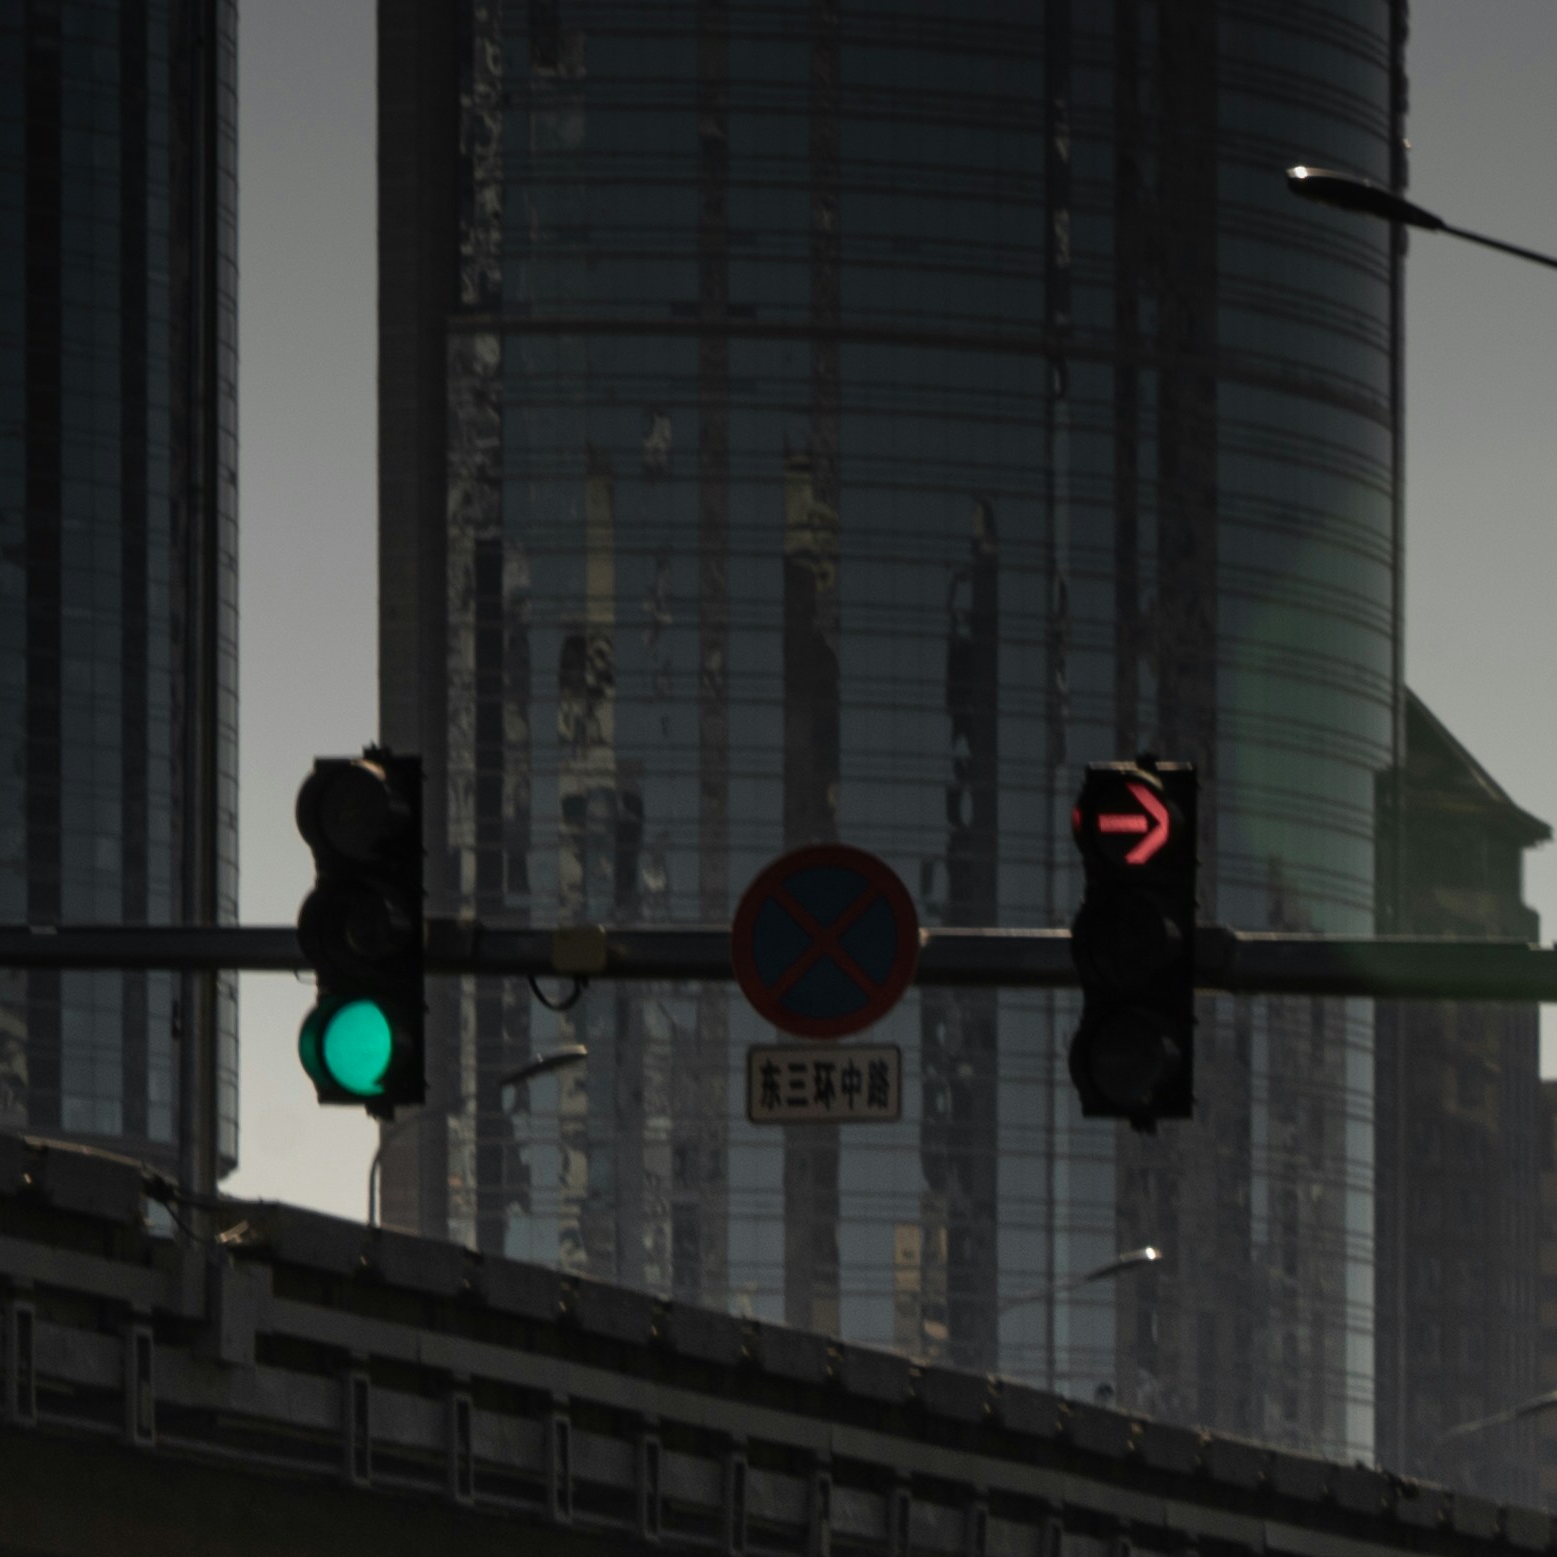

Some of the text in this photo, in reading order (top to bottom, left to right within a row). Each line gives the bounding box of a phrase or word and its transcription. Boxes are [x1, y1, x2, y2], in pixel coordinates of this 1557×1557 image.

[759, 1058, 891, 1112] 东三环中路
